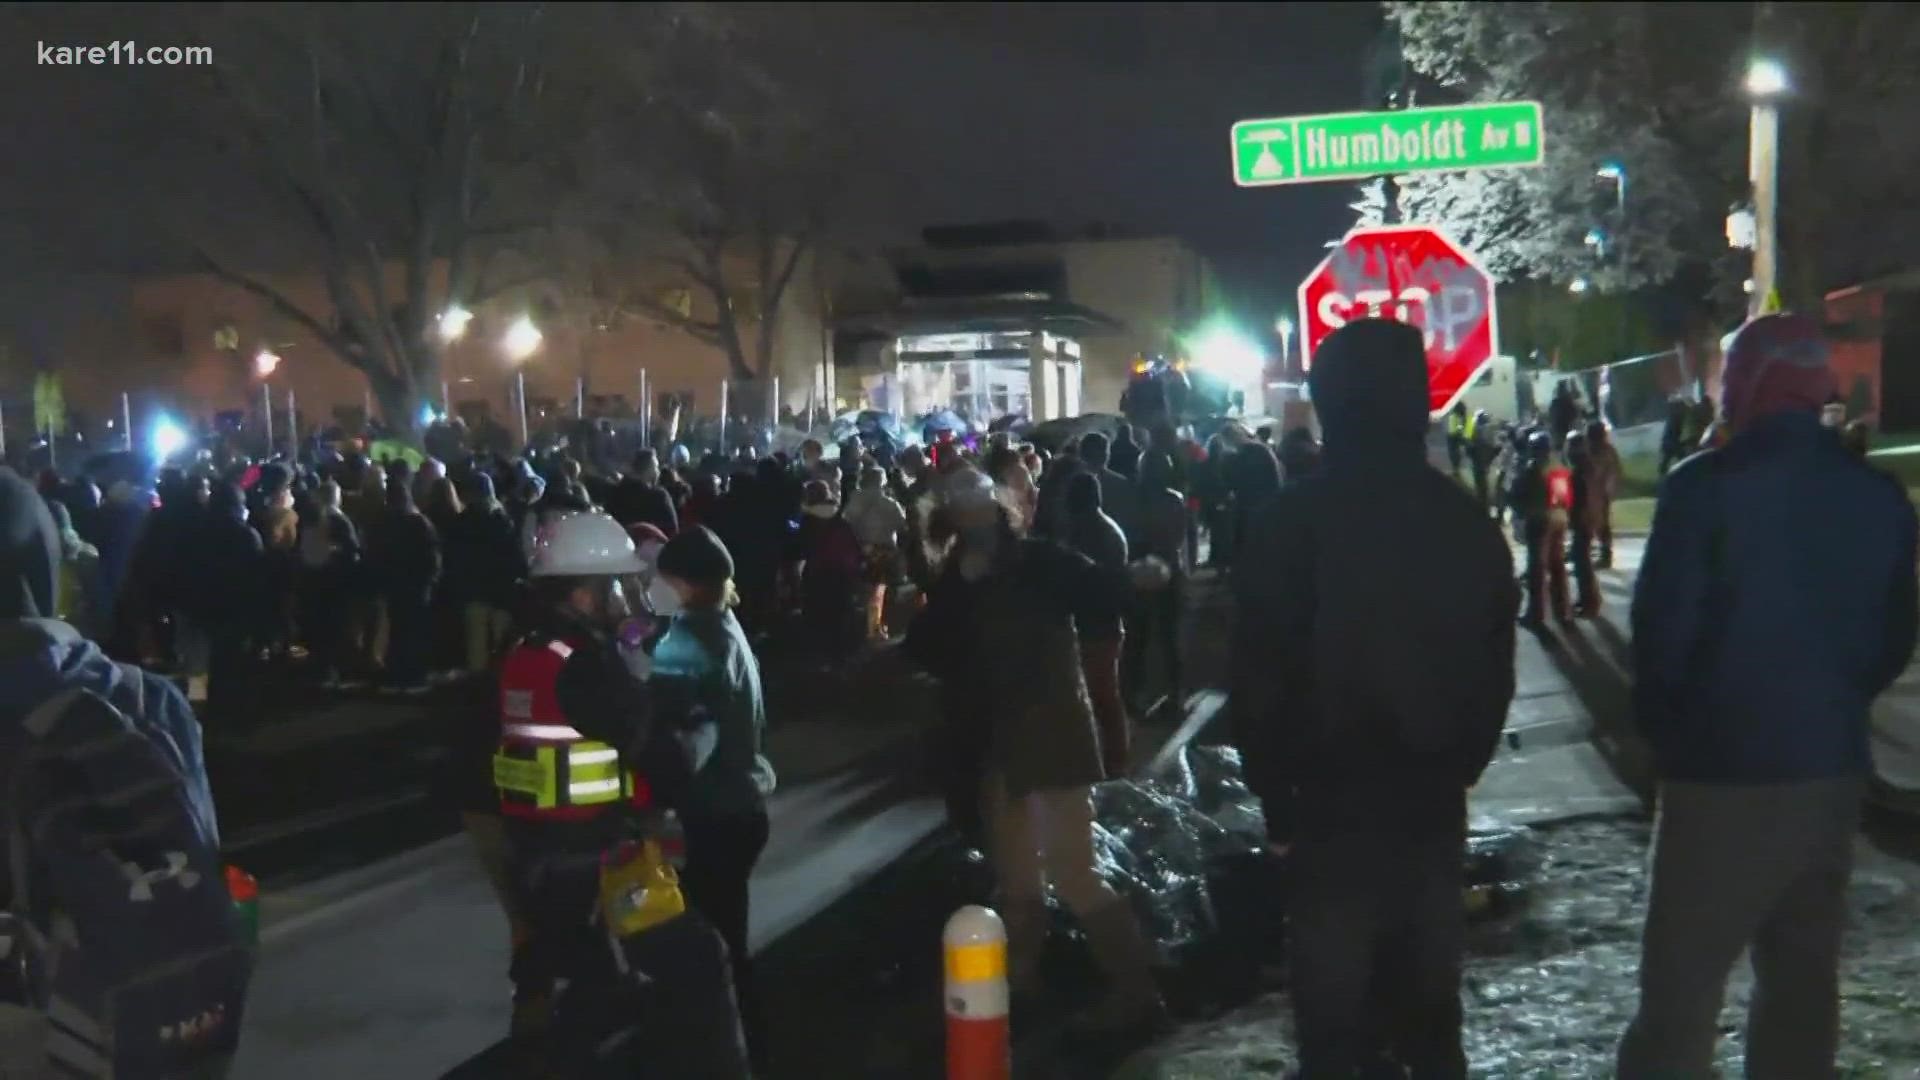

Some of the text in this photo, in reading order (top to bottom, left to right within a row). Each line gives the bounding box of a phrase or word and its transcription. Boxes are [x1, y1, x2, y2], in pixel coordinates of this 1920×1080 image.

[1305, 119, 1532, 168] Humboldt Av N
